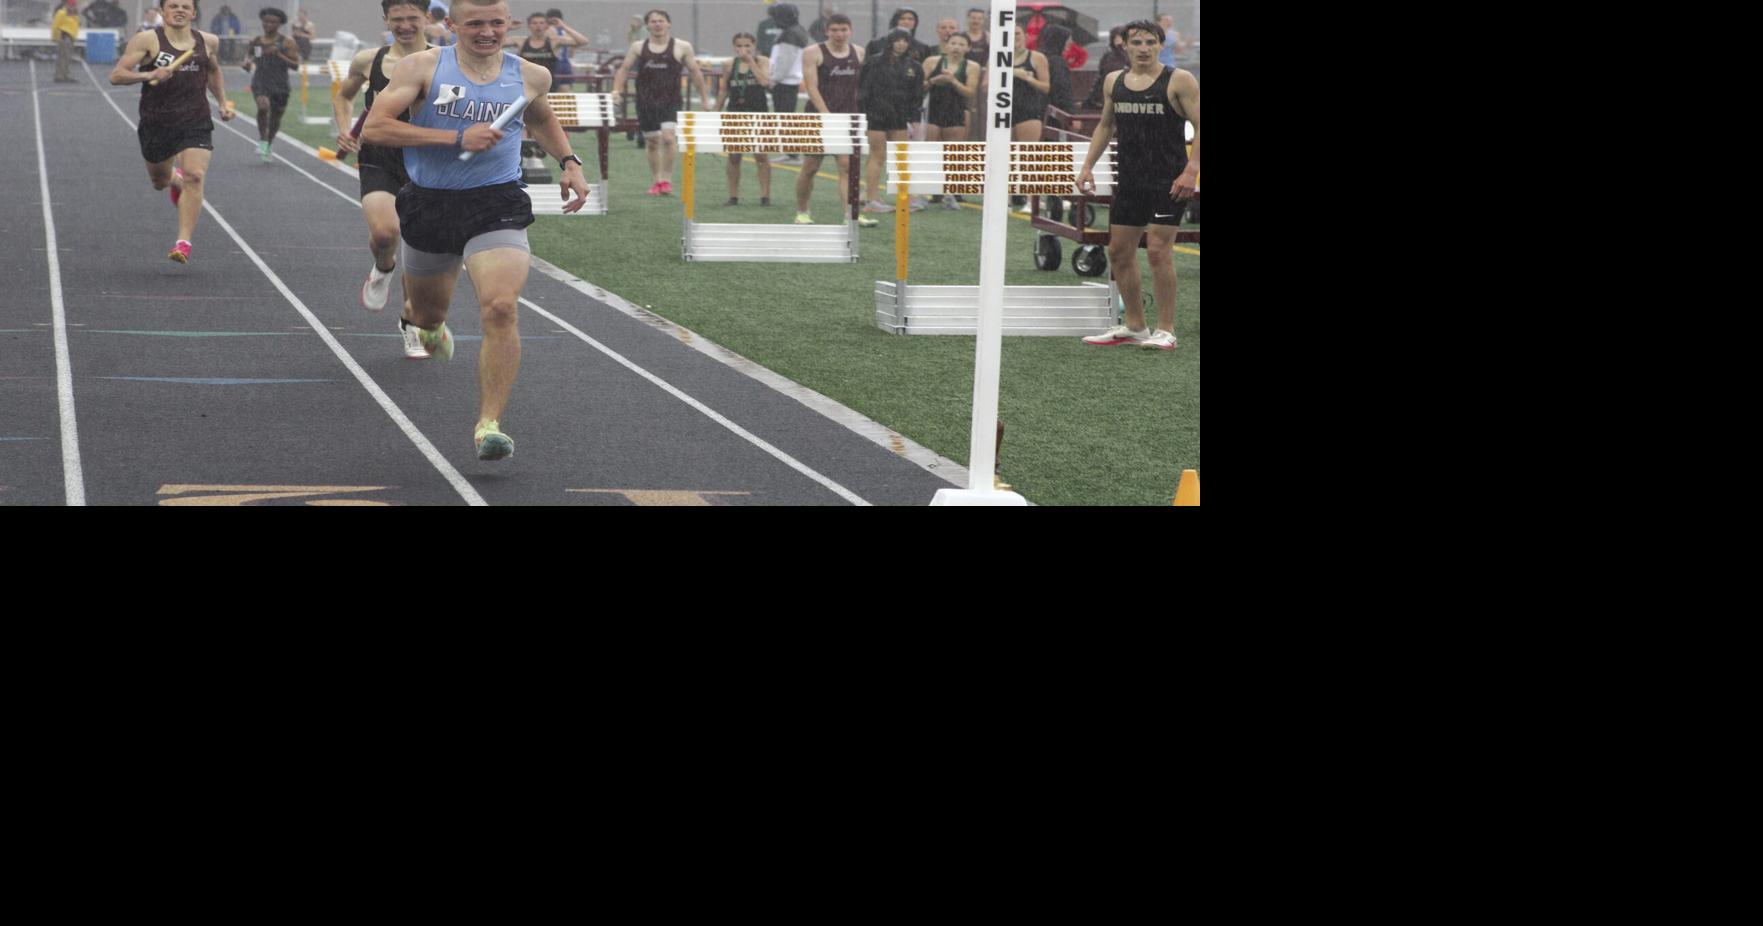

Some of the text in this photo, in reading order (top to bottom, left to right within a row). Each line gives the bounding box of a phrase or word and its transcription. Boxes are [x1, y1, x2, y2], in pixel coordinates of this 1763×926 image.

[158, 53, 171, 67] 5
[995, 11, 1013, 128] FINISH
[758, 145, 780, 153] LAKE
[782, 145, 825, 153] RANGERS
[943, 184, 985, 194] FOREST
[1020, 184, 1074, 194] RANGERS
